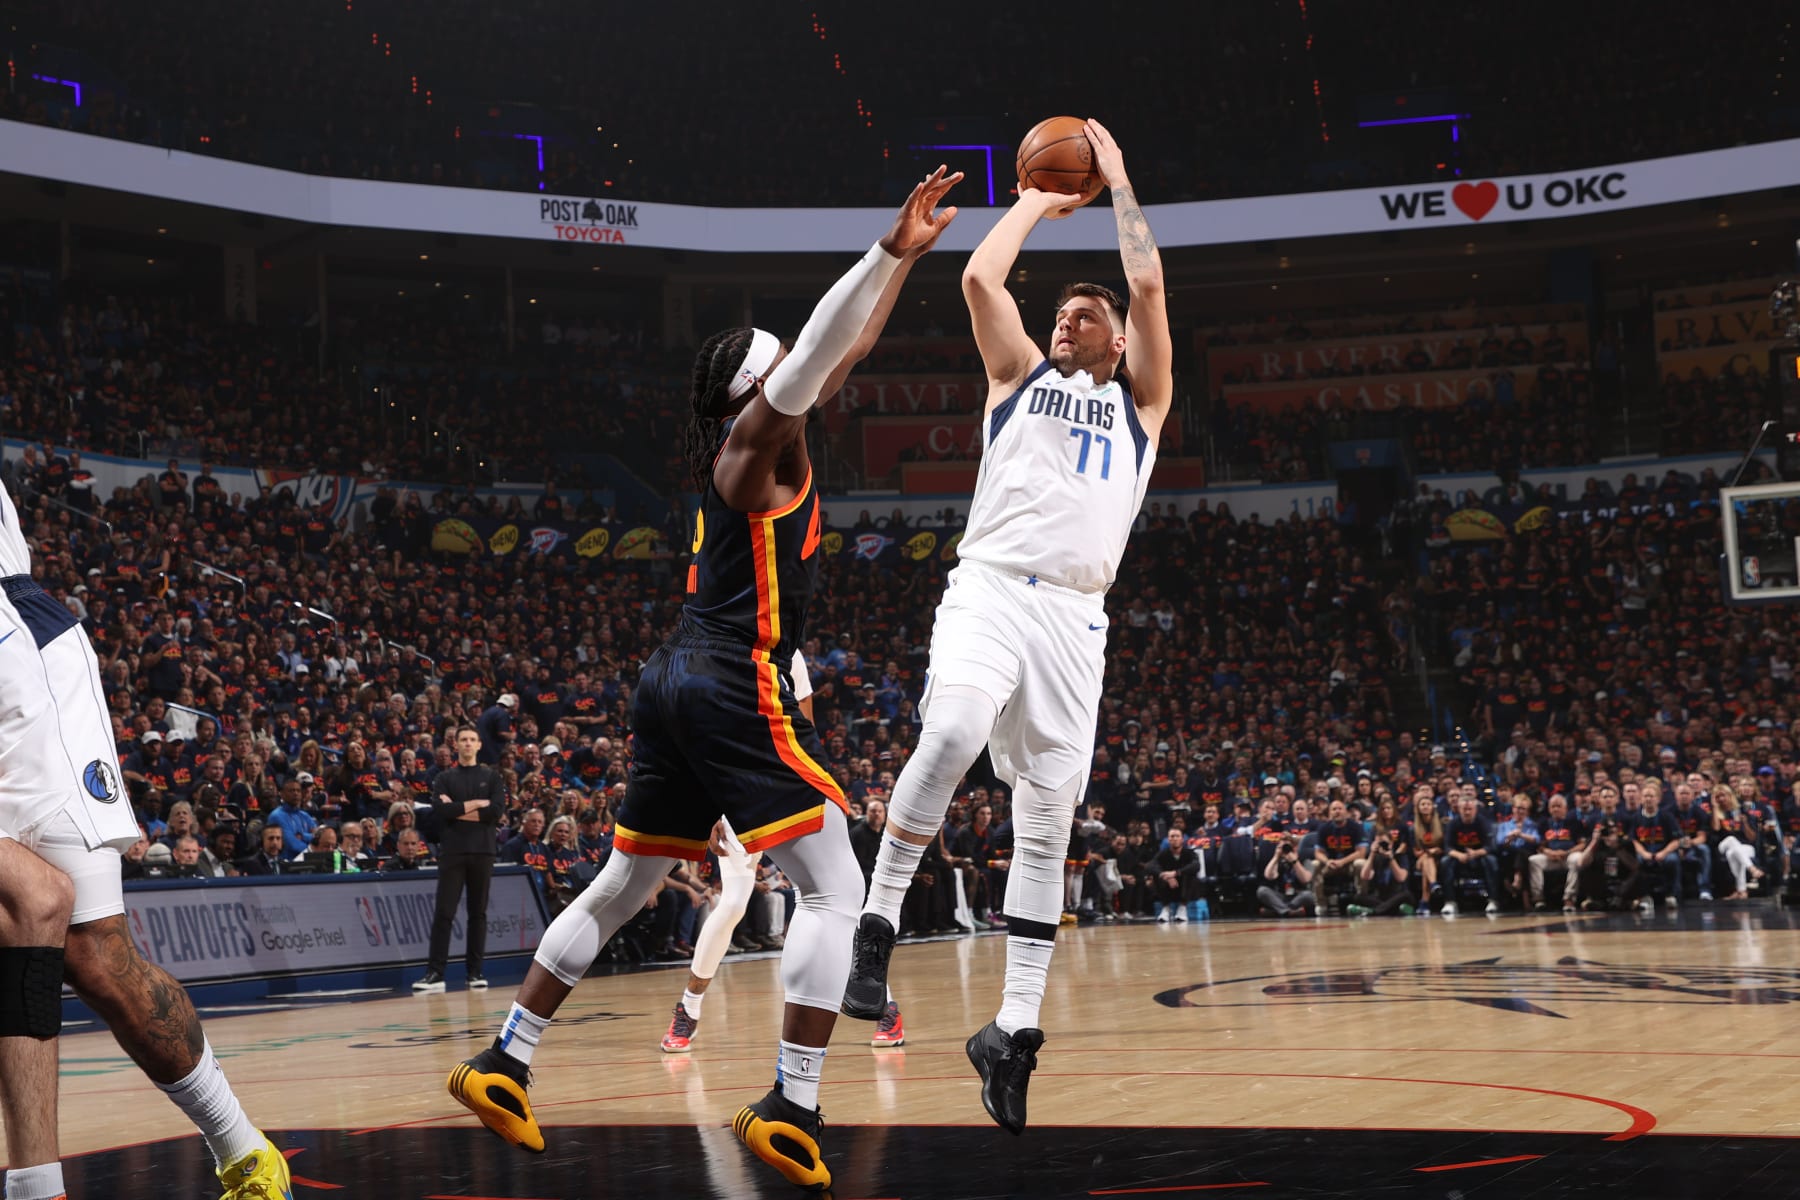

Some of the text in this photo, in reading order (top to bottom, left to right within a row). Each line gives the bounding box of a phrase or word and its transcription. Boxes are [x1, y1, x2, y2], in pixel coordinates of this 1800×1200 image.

[541, 199, 638, 226] POST OAK
[1380, 173, 1626, 220] WE U OKC
[554, 225, 625, 244] TOYOTA
[1028, 387, 1115, 431] DALLAS
[1070, 427, 1112, 480] 77
[145, 902, 256, 964] PLAYOFFS
[261, 927, 346, 953] Google Pixel
